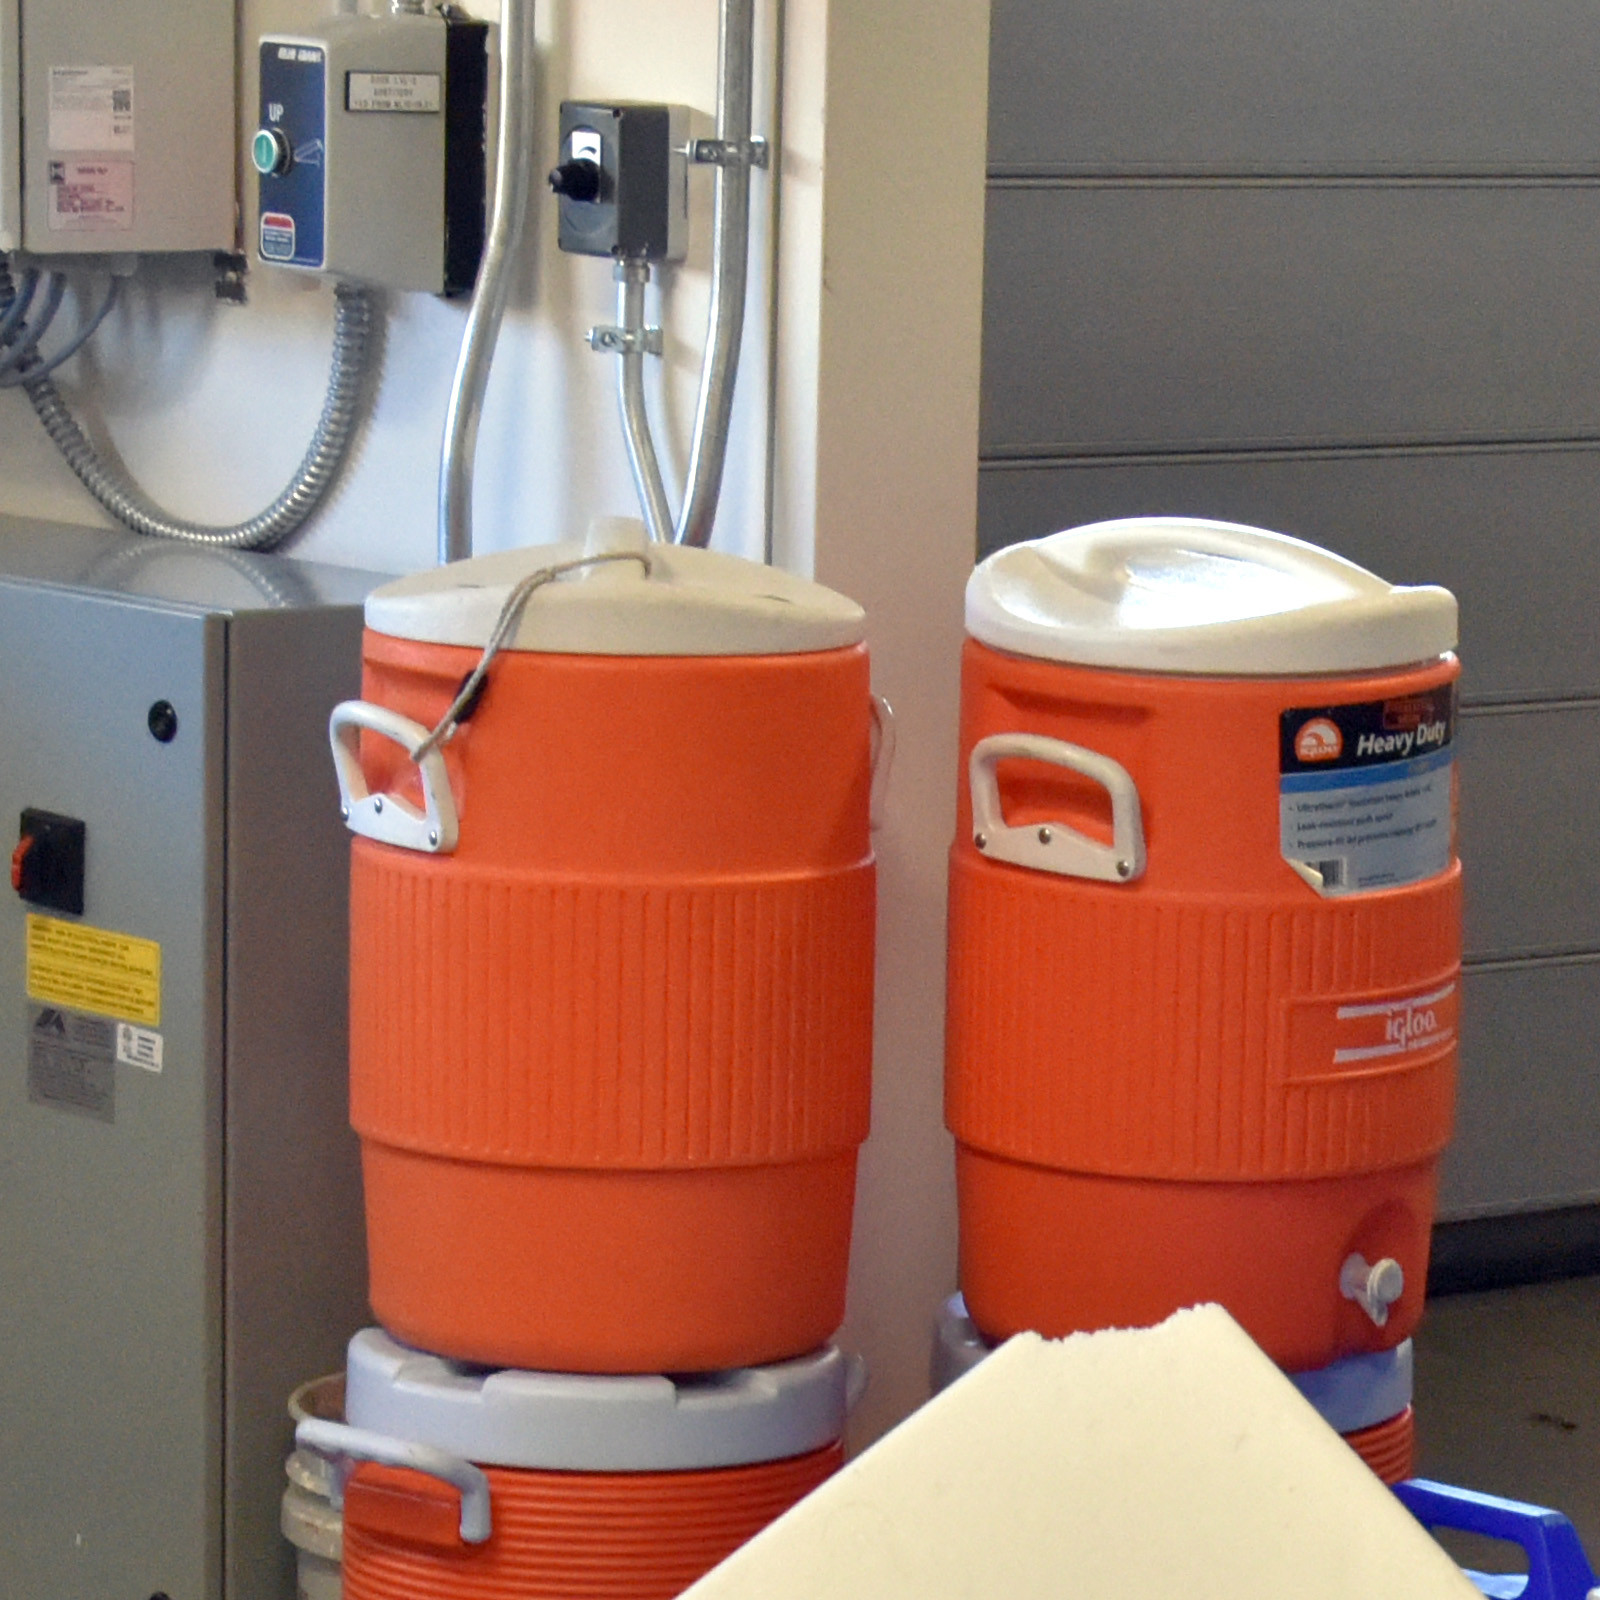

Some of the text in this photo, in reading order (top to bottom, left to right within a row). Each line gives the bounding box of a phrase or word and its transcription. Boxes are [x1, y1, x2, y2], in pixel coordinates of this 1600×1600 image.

[268, 103, 284, 122] UP
[1356, 720, 1446, 757] Heavy Duty
[1385, 1006, 1437, 1049] igloo
